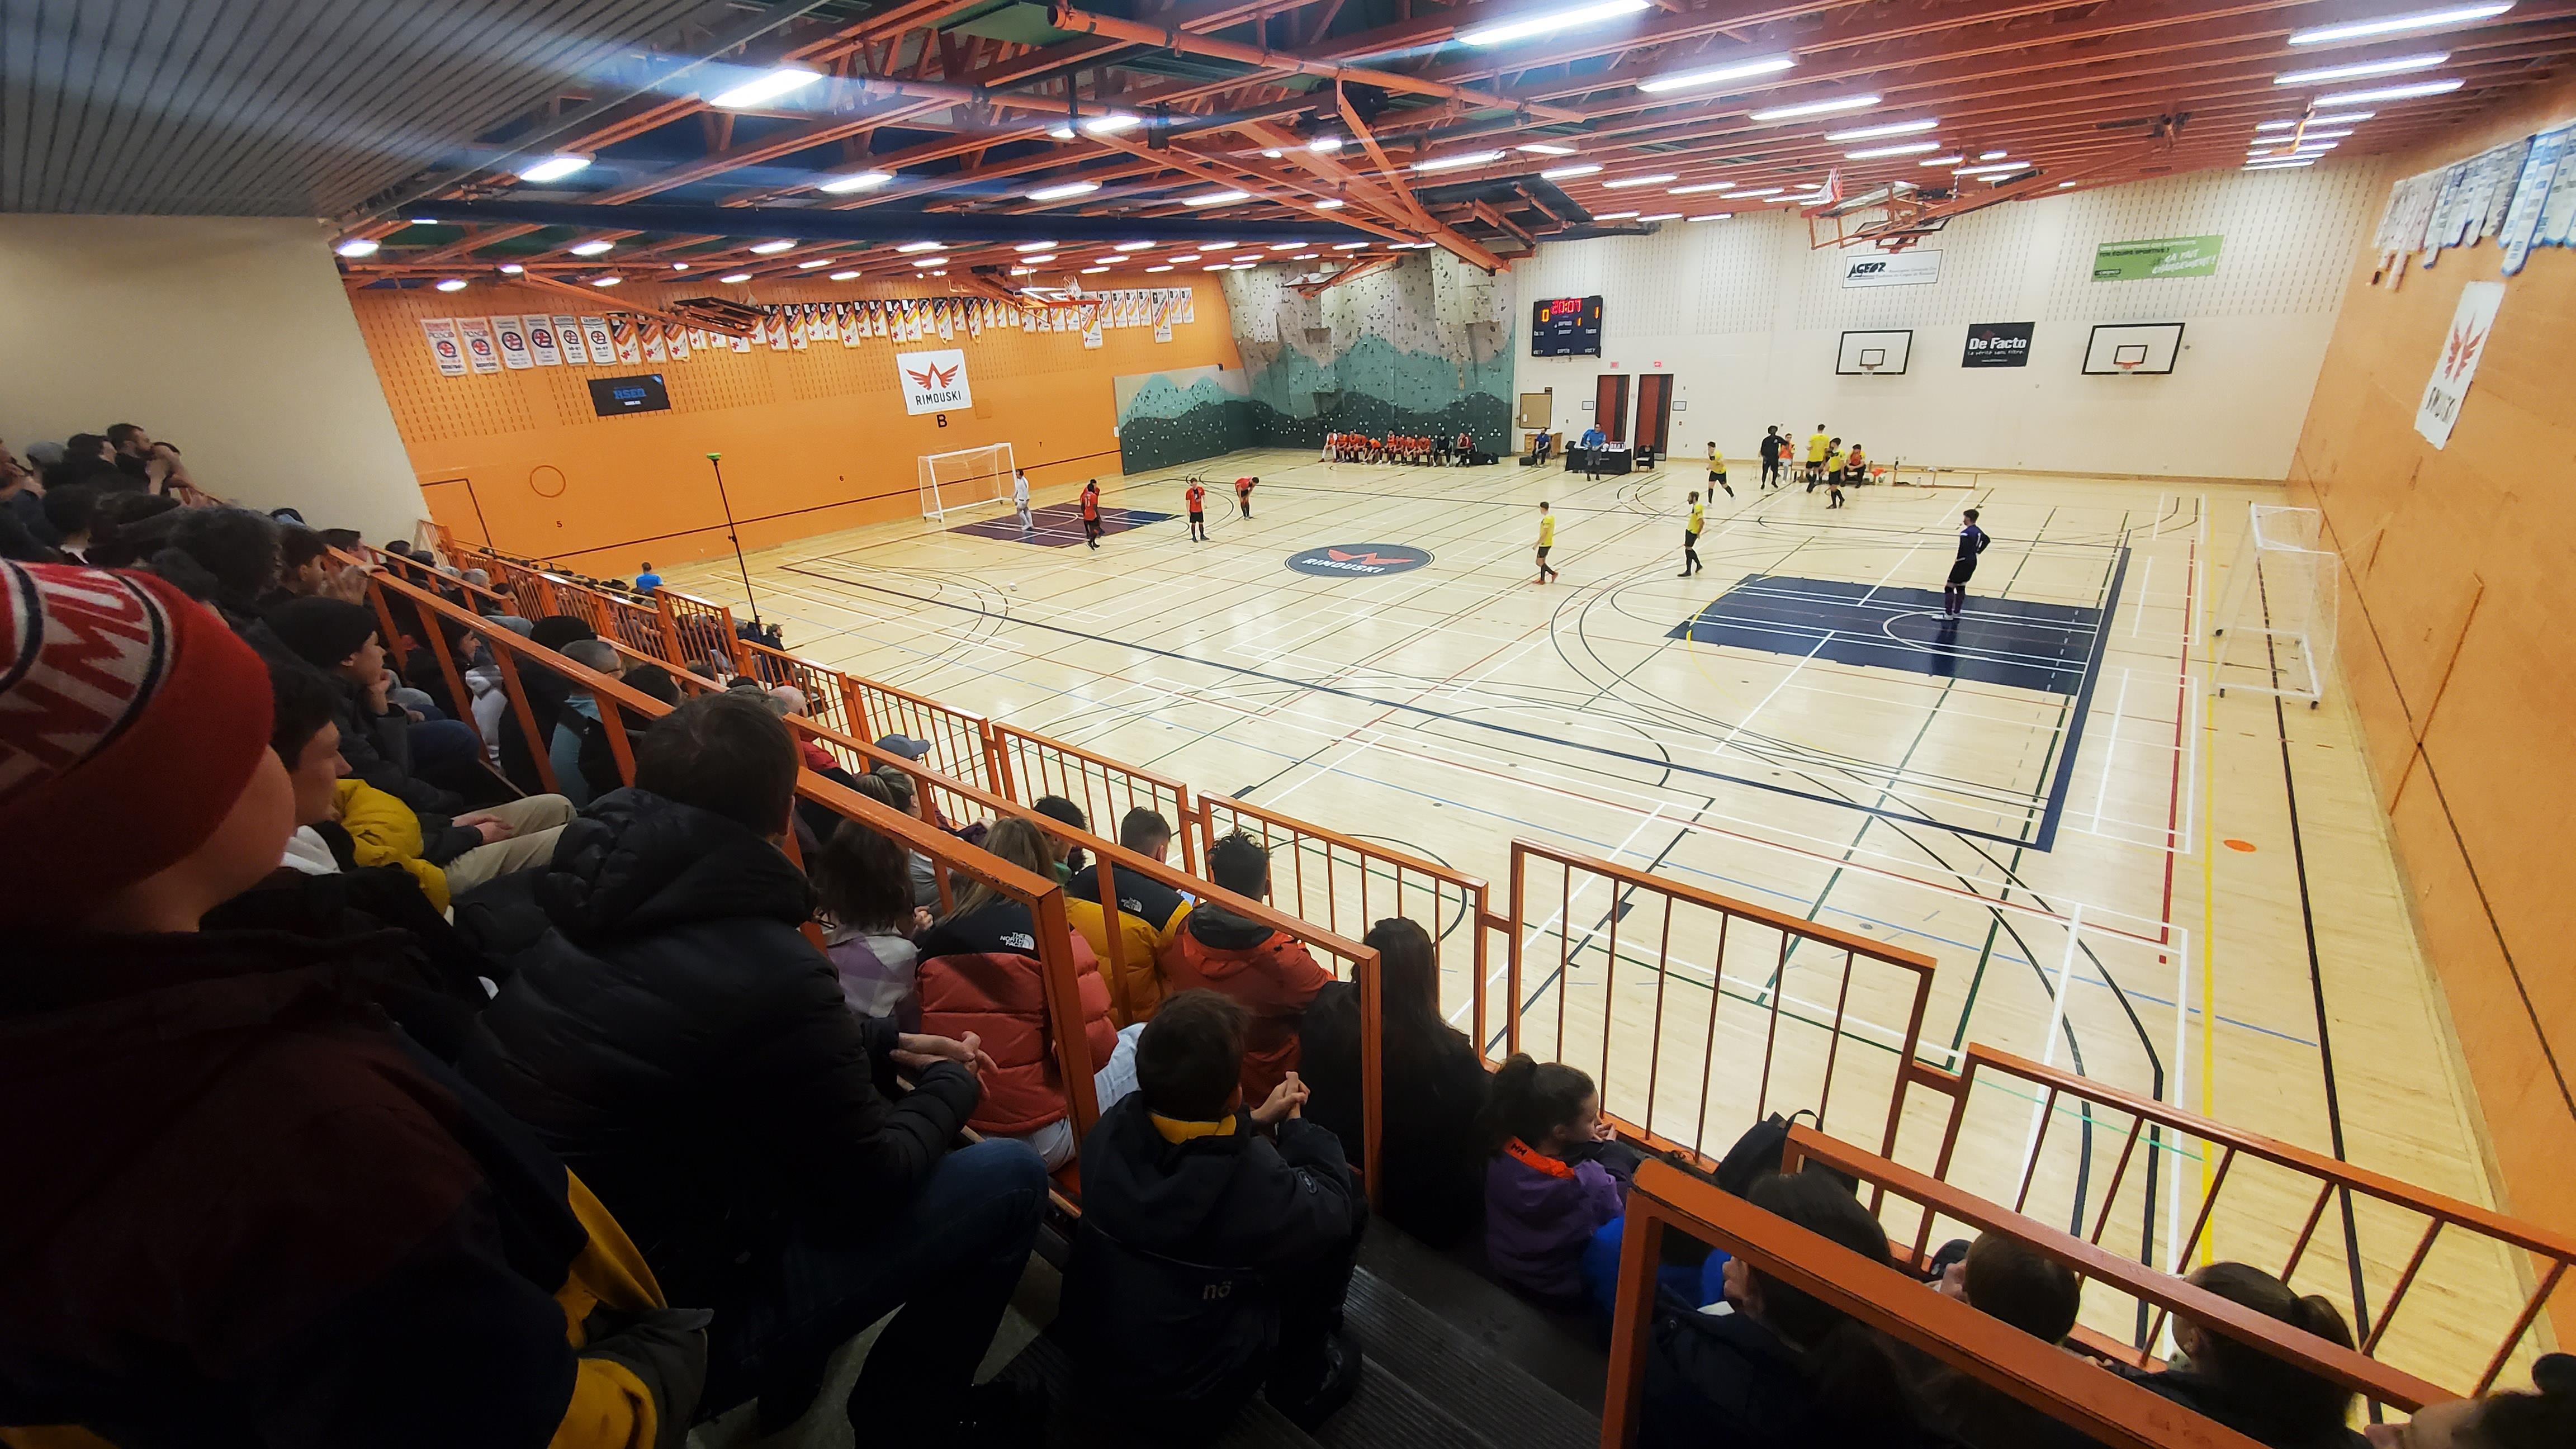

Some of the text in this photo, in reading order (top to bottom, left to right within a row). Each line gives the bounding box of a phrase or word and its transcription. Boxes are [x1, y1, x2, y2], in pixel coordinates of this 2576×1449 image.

[1541, 309, 1550, 322] 0
[1969, 337, 2027, 350] De Facto
[915, 390, 962, 406] RIMOUSKI
[936, 414, 948, 428] B
[1301, 558, 1386, 574] RIMOUSKI
[1000, 935, 1024, 944] NORTH
